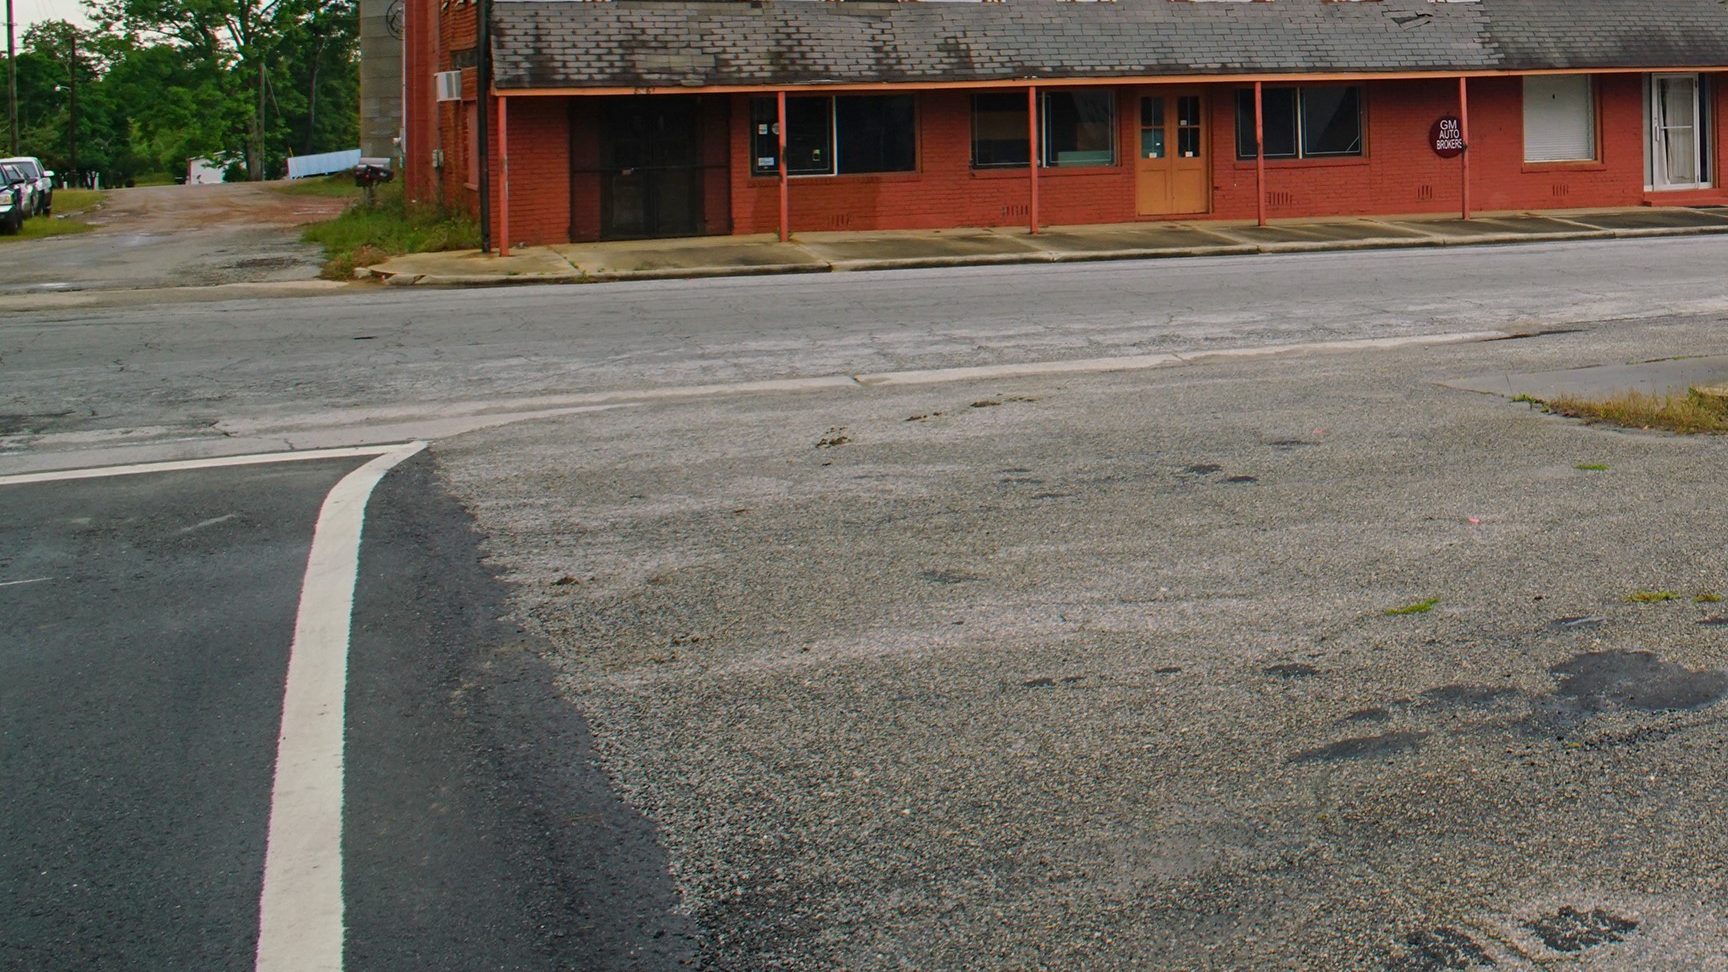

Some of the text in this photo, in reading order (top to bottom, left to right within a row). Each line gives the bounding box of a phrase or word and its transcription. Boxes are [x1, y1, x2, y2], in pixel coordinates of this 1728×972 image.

[1440, 119, 1457, 130] GM
[1439, 129, 1460, 139] AUTO
[1436, 138, 1463, 150] BROKERS
